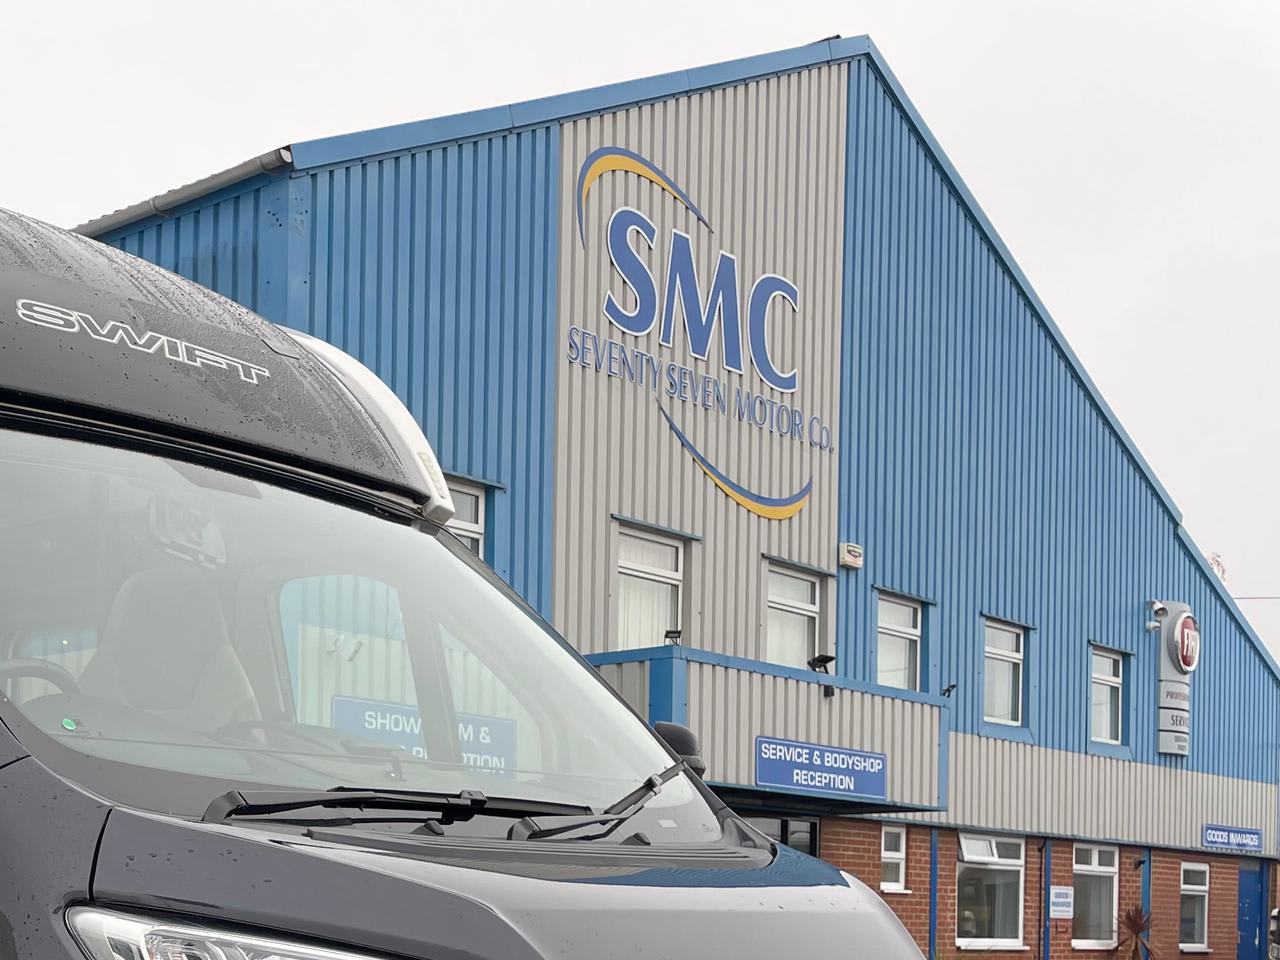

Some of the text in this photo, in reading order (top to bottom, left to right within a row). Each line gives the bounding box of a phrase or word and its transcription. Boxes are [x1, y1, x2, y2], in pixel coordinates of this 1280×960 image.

[602, 206, 799, 393] SMC
[16, 299, 271, 384] SWIFT
[567, 325, 662, 392] SEVENTY
[665, 361, 726, 416] SEVEN
[733, 386, 804, 442] MOTOR
[479, 727, 491, 743] &
[761, 743, 883, 773] SERVICE & BODYSHOP
[793, 769, 855, 790] RECEPTION
[1207, 830, 1258, 846] GOODS INWARDS
